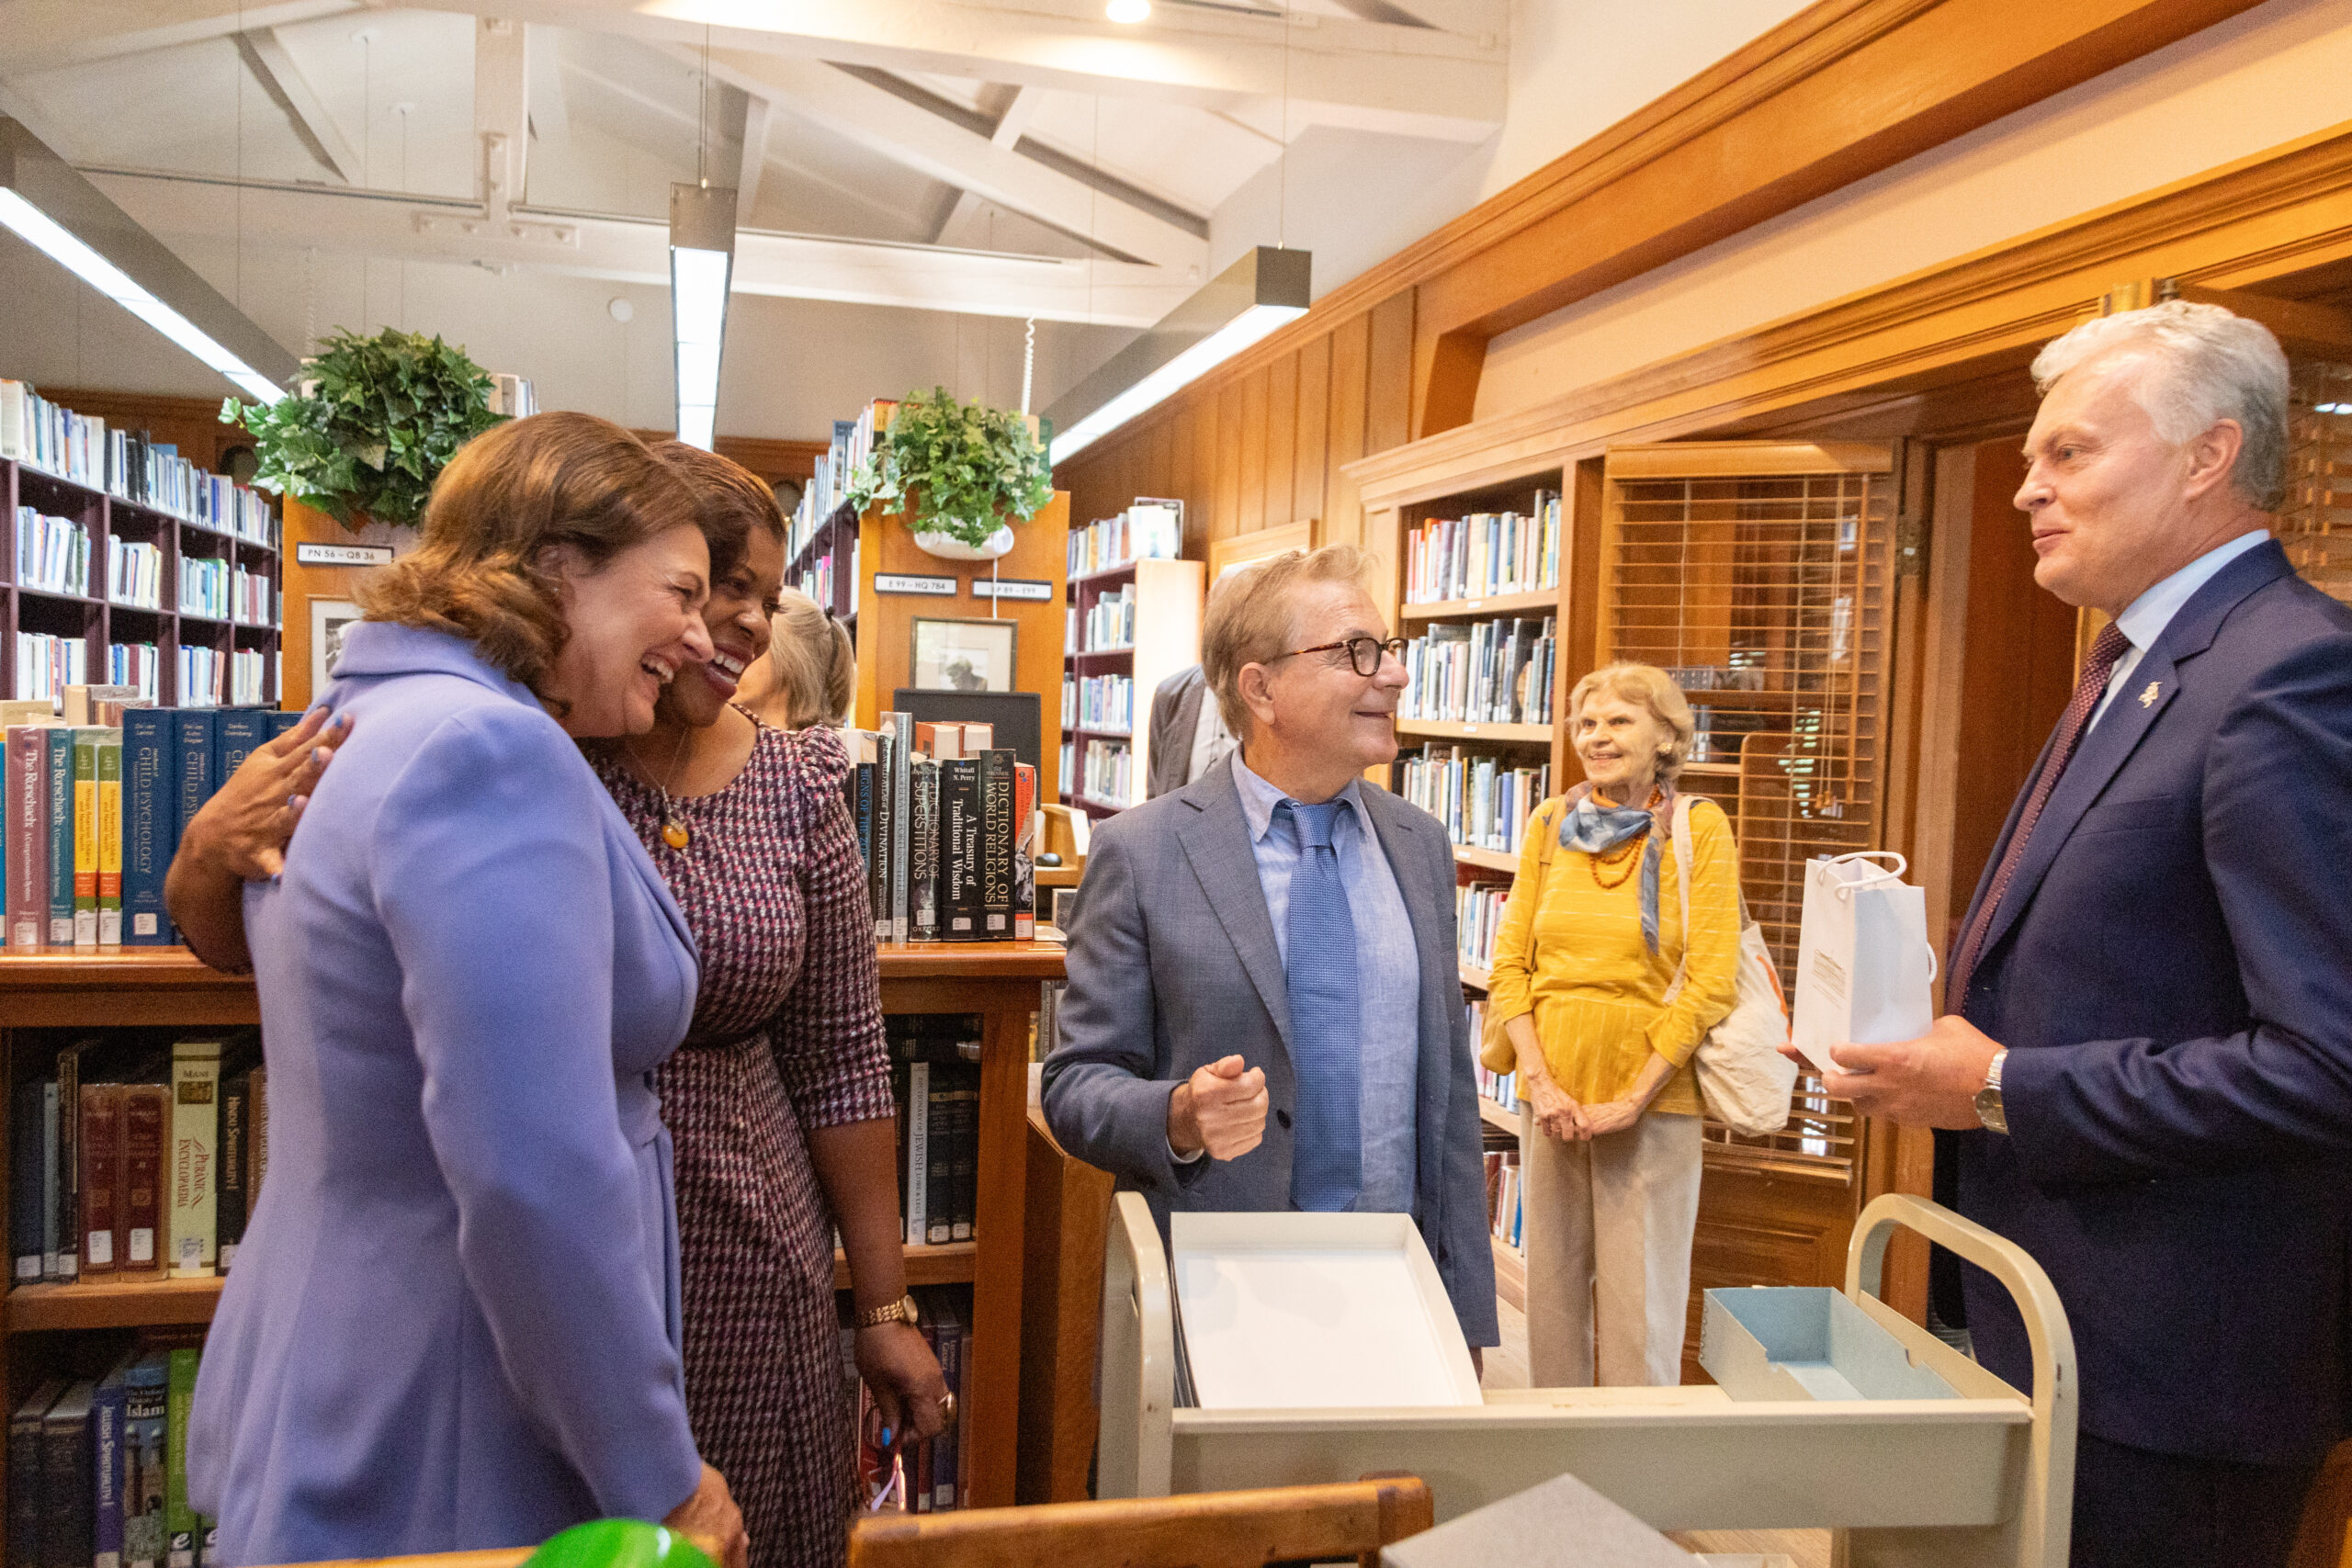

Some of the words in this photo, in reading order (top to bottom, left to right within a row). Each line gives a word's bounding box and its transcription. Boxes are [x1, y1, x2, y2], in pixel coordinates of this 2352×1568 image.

[308, 549, 322, 558] PN
[346, 550, 361, 559] QB
[364, 551, 375, 560] 36
[915, 581, 929, 590] HQ
[24, 750, 38, 772] The
[53, 747, 66, 767] The
[140, 747, 153, 788] CHILD
[187, 751, 198, 792] CHILD
[24, 772, 38, 828] Rorschach:
[53, 768, 66, 826] Rorschach:
[859, 799, 868, 811] OF
[986, 782, 997, 830] WORLD
[140, 792, 153, 874] PSYCHOLOGY
[859, 816, 868, 835] THE
[914, 781, 927, 880] SUPERSTITIONS
[929, 791, 939, 863] DICTIONARY
[952, 798, 963, 855] Traditional
[966, 814, 977, 823] A
[998, 781, 1009, 875] DICTIONARY
[964, 827, 977, 872] Treasury
[985, 833, 997, 903] RELIGIONS
[929, 863, 939, 879] OF
[952, 859, 963, 900] Wisdom
[966, 875, 977, 886] of
[998, 883, 1009, 903] OF
[913, 1133, 924, 1171] JEWISH
[127, 1404, 165, 1416] Islam
